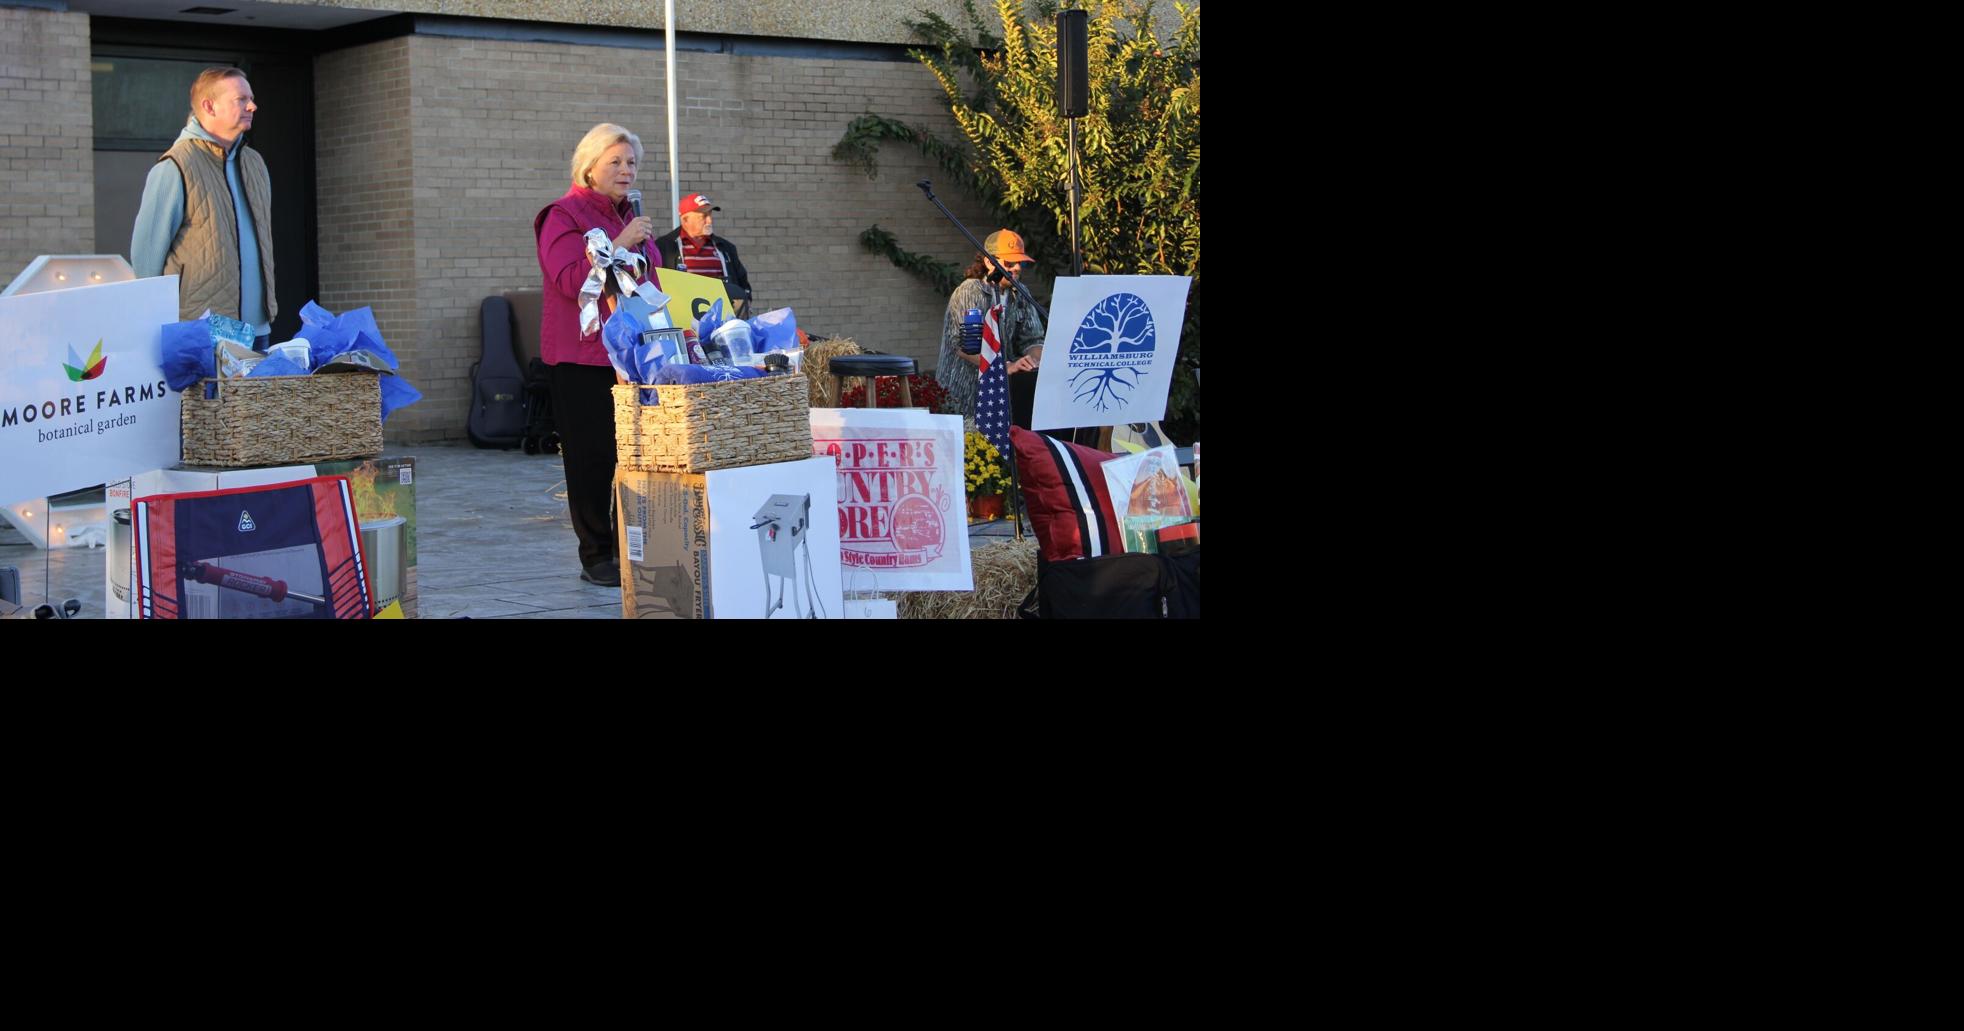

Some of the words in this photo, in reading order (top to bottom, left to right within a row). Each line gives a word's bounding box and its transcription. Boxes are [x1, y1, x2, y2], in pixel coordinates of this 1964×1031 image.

[1069, 352, 1153, 361] WILLIAMSBURG
[1, 394, 86, 428] MOORE
[96, 380, 166, 409] FARMS
[38, 418, 94, 443] botanical
[98, 413, 137, 435] garden
[109, 489, 129, 498] BONFIRE
[693, 551, 701, 585] BAYOU
[844, 551, 864, 564] Style
[865, 552, 898, 567] Country
